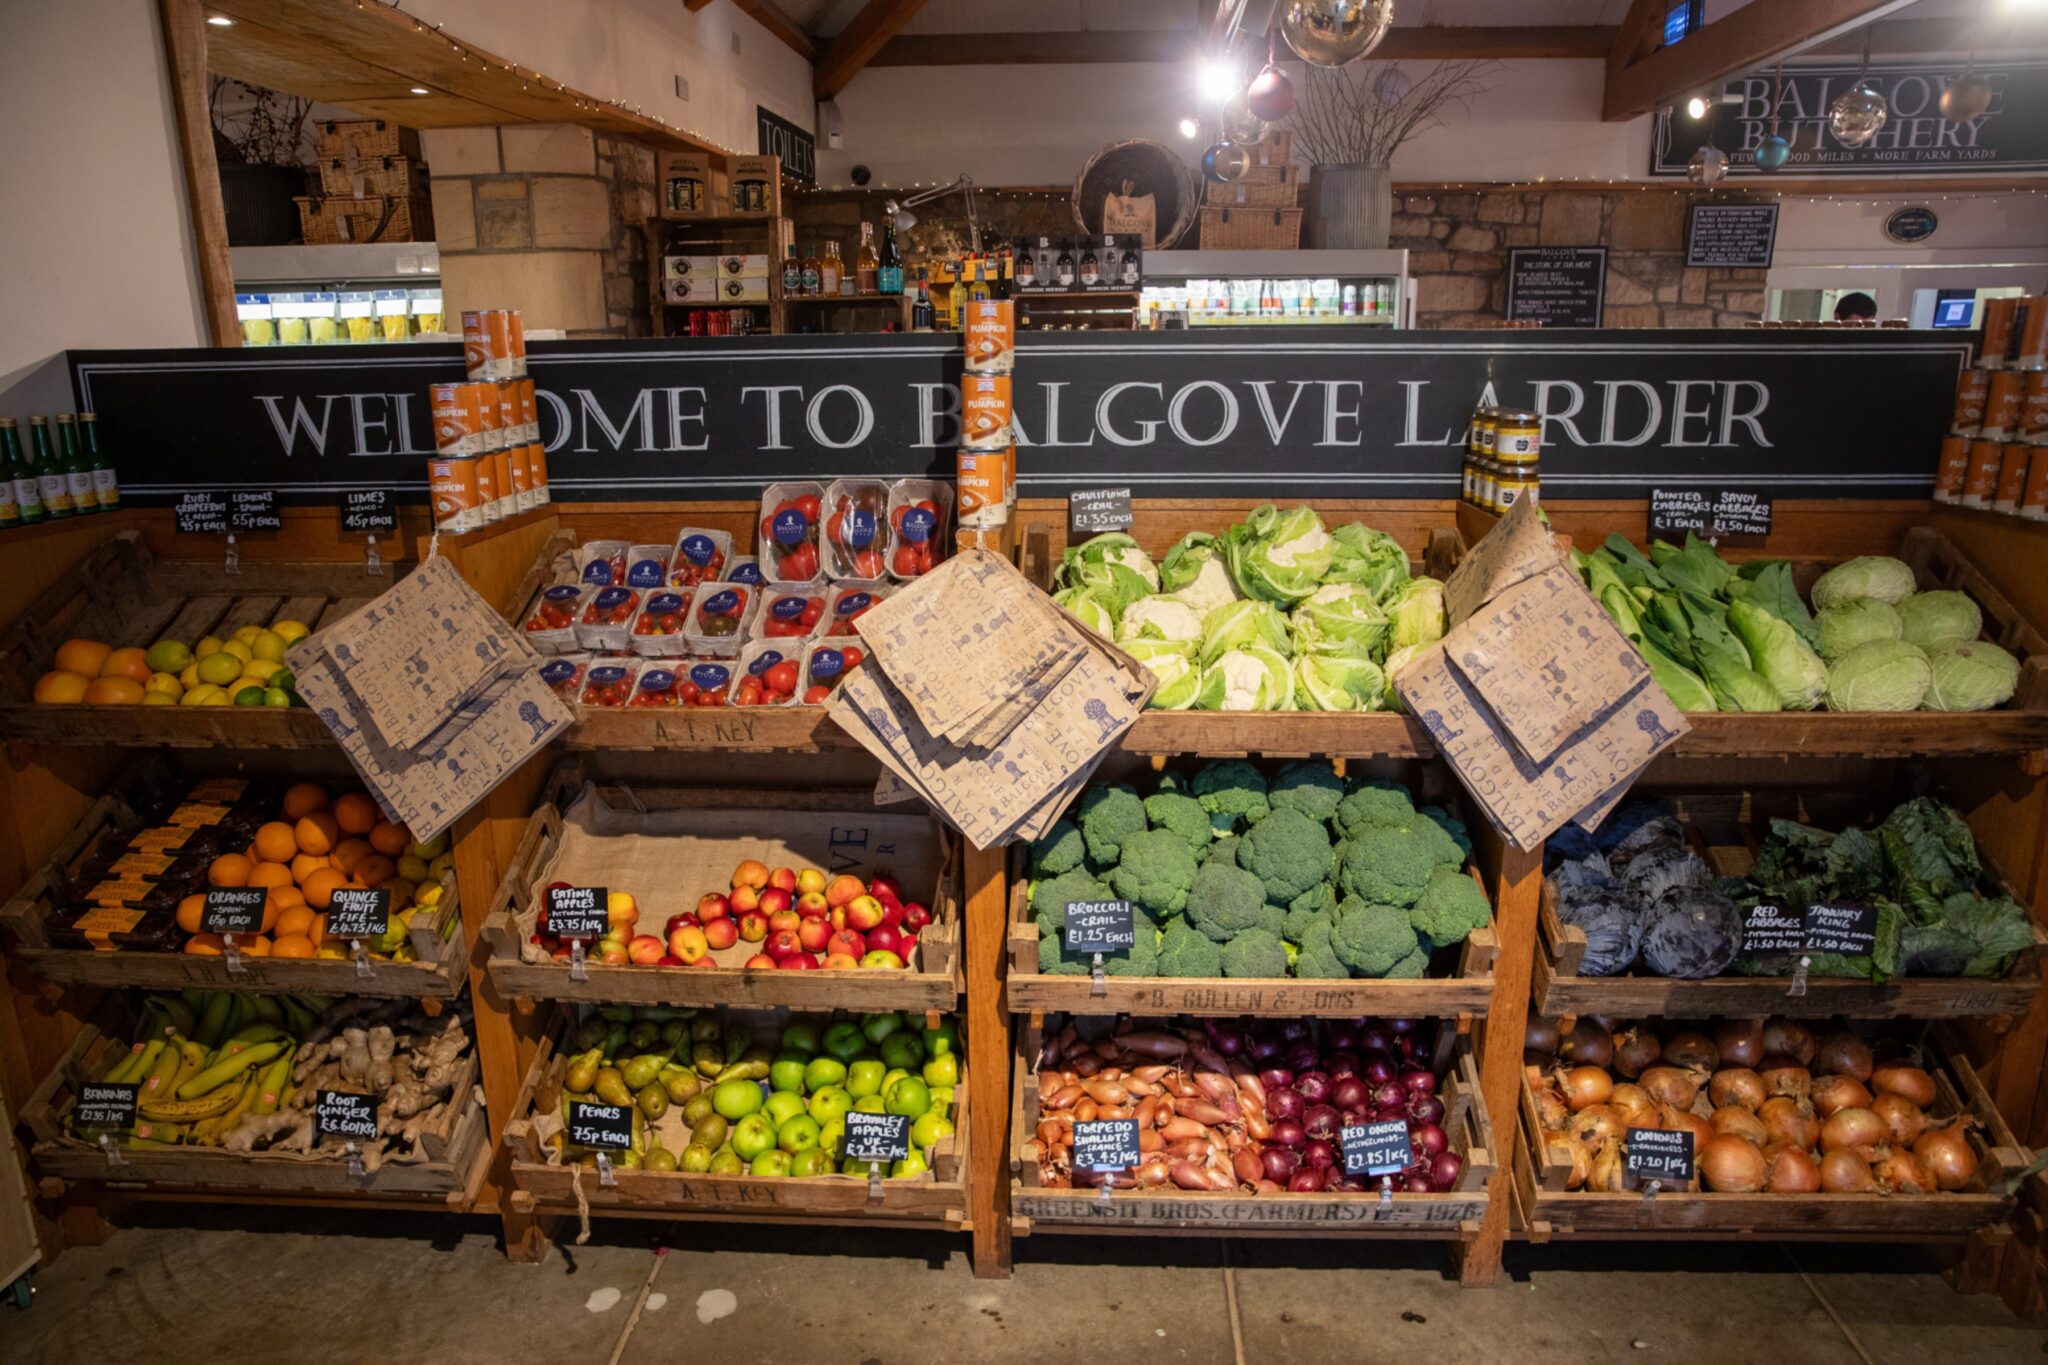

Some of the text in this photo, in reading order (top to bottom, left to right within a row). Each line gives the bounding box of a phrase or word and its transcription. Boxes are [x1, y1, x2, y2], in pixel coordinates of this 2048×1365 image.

[762, 118, 813, 177] TOILETS
[1817, 151, 1855, 162] MILES
[1874, 150, 1909, 161] MORE
[1916, 150, 1950, 160] FARM
[1957, 149, 1997, 160] YARDS
[971, 325, 1007, 333] PUMPKIN
[968, 400, 1005, 408] PUMPKIN
[253, 386, 709, 457] WELOME
[741, 383, 875, 452] TO
[184, 494, 211, 503] RUBY
[233, 492, 273, 502] LEMONS
[348, 492, 385, 503] LIMES
[1653, 489, 1702, 501] POINTED
[1721, 491, 1757, 504] SAVOY
[1652, 501, 1711, 513] CABBAGES
[1713, 504, 1770, 516] CABBAGES
[203, 521, 227, 531] EACH
[232, 514, 280, 527] 55p EACH
[346, 515, 393, 528] 45p EACH
[1076, 512, 1109, 527] £1.35
[1655, 517, 1704, 529] £1 EACH
[1714, 520, 1766, 533] £1.50 EACH
[351, 665, 405, 726] BALGOVE
[1018, 662, 1096, 732] BALGOVE
[1482, 672, 1552, 751] BALGOVE
[715, 719, 756, 742] KEY
[344, 736, 423, 825] BALGOVE
[439, 758, 491, 805] BALGOVE
[895, 736, 981, 834] BALGOVE
[998, 759, 1054, 809] BALGOVE
[1441, 734, 1529, 834] BALGOVE
[1546, 765, 1603, 815] BALGOVE
[208, 892, 261, 903] ORANGES
[333, 891, 379, 903] QUINCE
[552, 888, 594, 900] EATING
[342, 903, 378, 913] FRUIT
[555, 898, 595, 909] APPLES
[1068, 901, 1129, 915] BROCCOLI
[1752, 906, 1778, 917] RED
[1808, 905, 1863, 921] JANUARY
[208, 916, 251, 926] 65p EACH
[1745, 918, 1800, 928] CABBAGES
[1817, 917, 1851, 929] KING
[1069, 927, 1133, 944] £1.25 EACH
[1744, 940, 1800, 950] £1.50 EACH
[1806, 937, 1863, 951] £1.50 EACH
[83, 1088, 133, 1100] BANANAS
[326, 1092, 360, 1107] ROOT
[318, 1105, 372, 1121] GINGER
[579, 1104, 620, 1119] PEARS
[847, 1112, 905, 1128] BRAMLEY
[852, 1124, 900, 1138] APPLES
[1076, 1122, 1133, 1135] TORPEDO
[1341, 1121, 1407, 1141] RED ONIONS
[573, 1126, 629, 1147] 75p EACH
[1075, 1132, 1130, 1146] SHALLOTS
[1635, 1131, 1683, 1144] ONIONS
